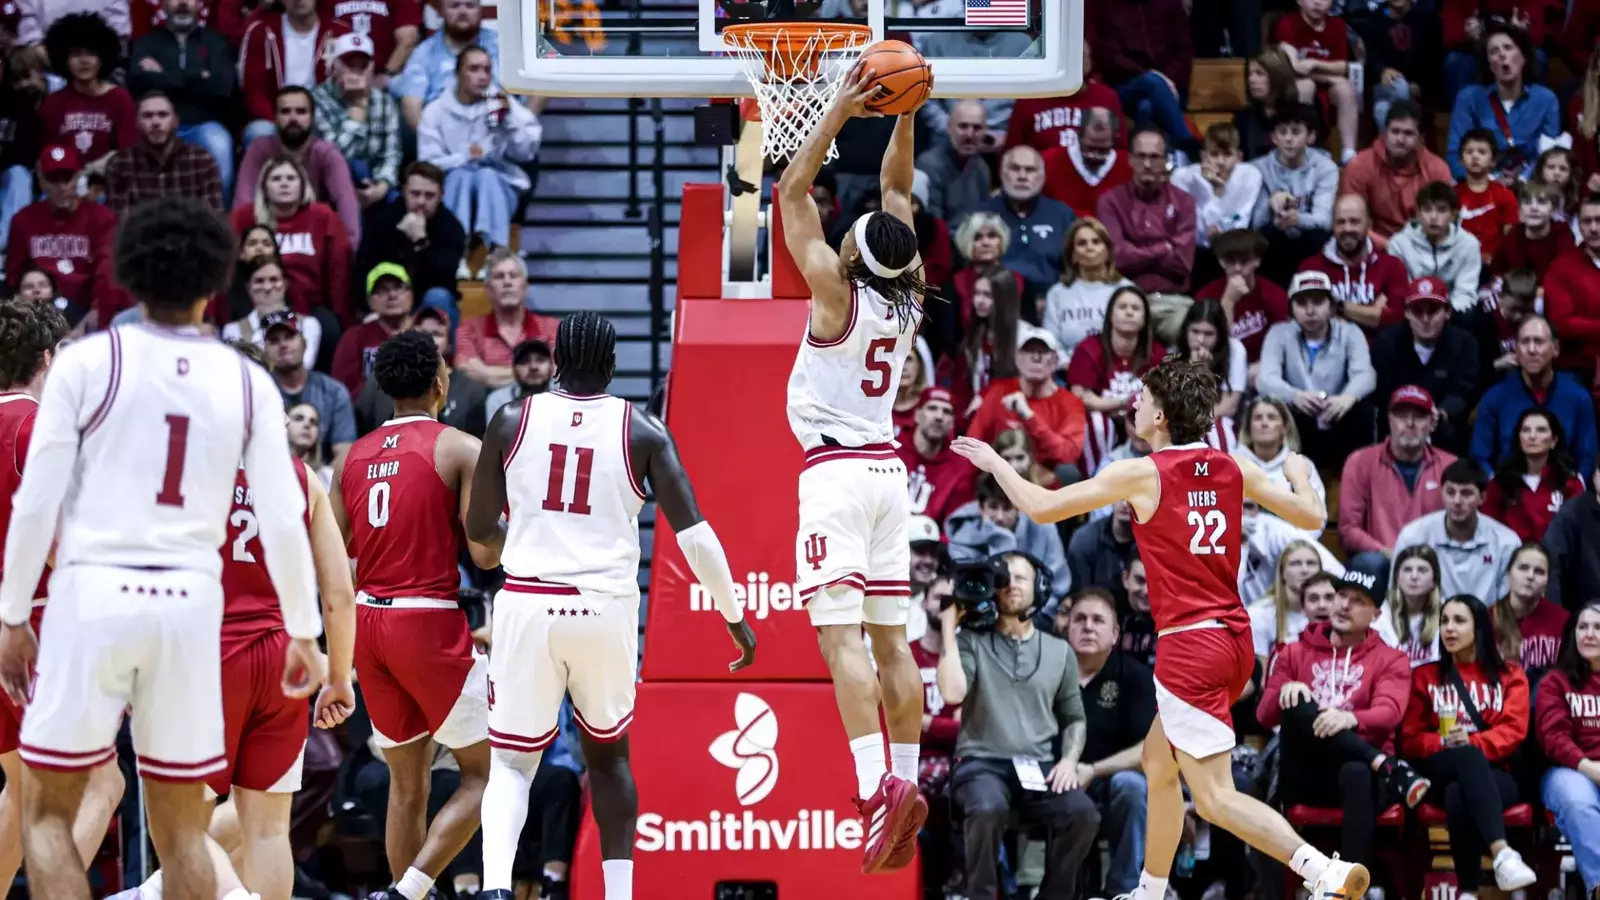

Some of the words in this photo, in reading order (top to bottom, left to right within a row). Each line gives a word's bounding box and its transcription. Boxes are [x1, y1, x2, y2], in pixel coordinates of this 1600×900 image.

[860, 338, 898, 398] 5
[156, 413, 190, 508] 1
[382, 434, 400, 449] M
[367, 460, 400, 480] ELMER
[541, 443, 595, 515] 11
[1193, 461, 1209, 476] M
[367, 480, 391, 529] 0
[1187, 490, 1217, 508] BYERS
[1187, 509, 1227, 555] 22
[635, 809, 863, 851] Smithville
